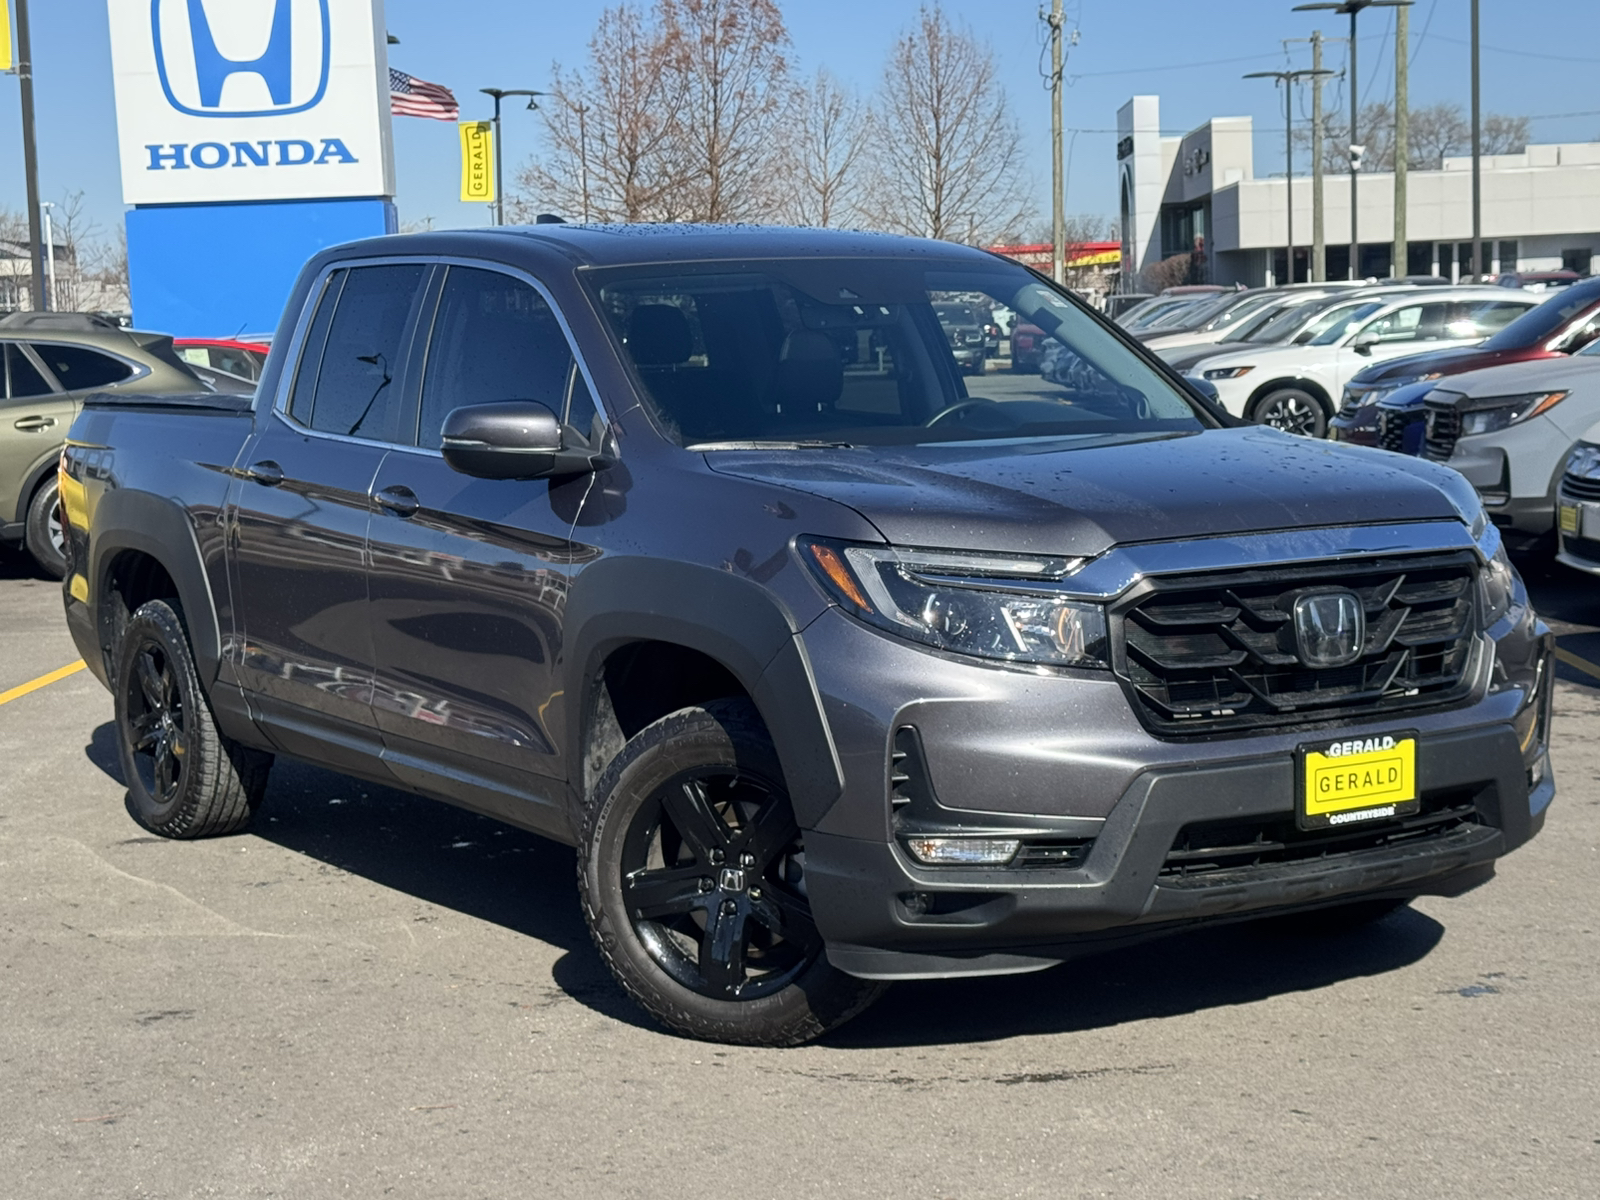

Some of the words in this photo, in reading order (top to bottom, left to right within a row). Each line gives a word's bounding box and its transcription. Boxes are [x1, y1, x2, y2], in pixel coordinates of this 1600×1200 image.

[145, 138, 359, 170] HONDA
[472, 131, 483, 191] GERALD
[1330, 736, 1394, 757] GERALD
[1319, 767, 1398, 793] GERALD
[1330, 806, 1395, 825] COUNTRYSIDE
